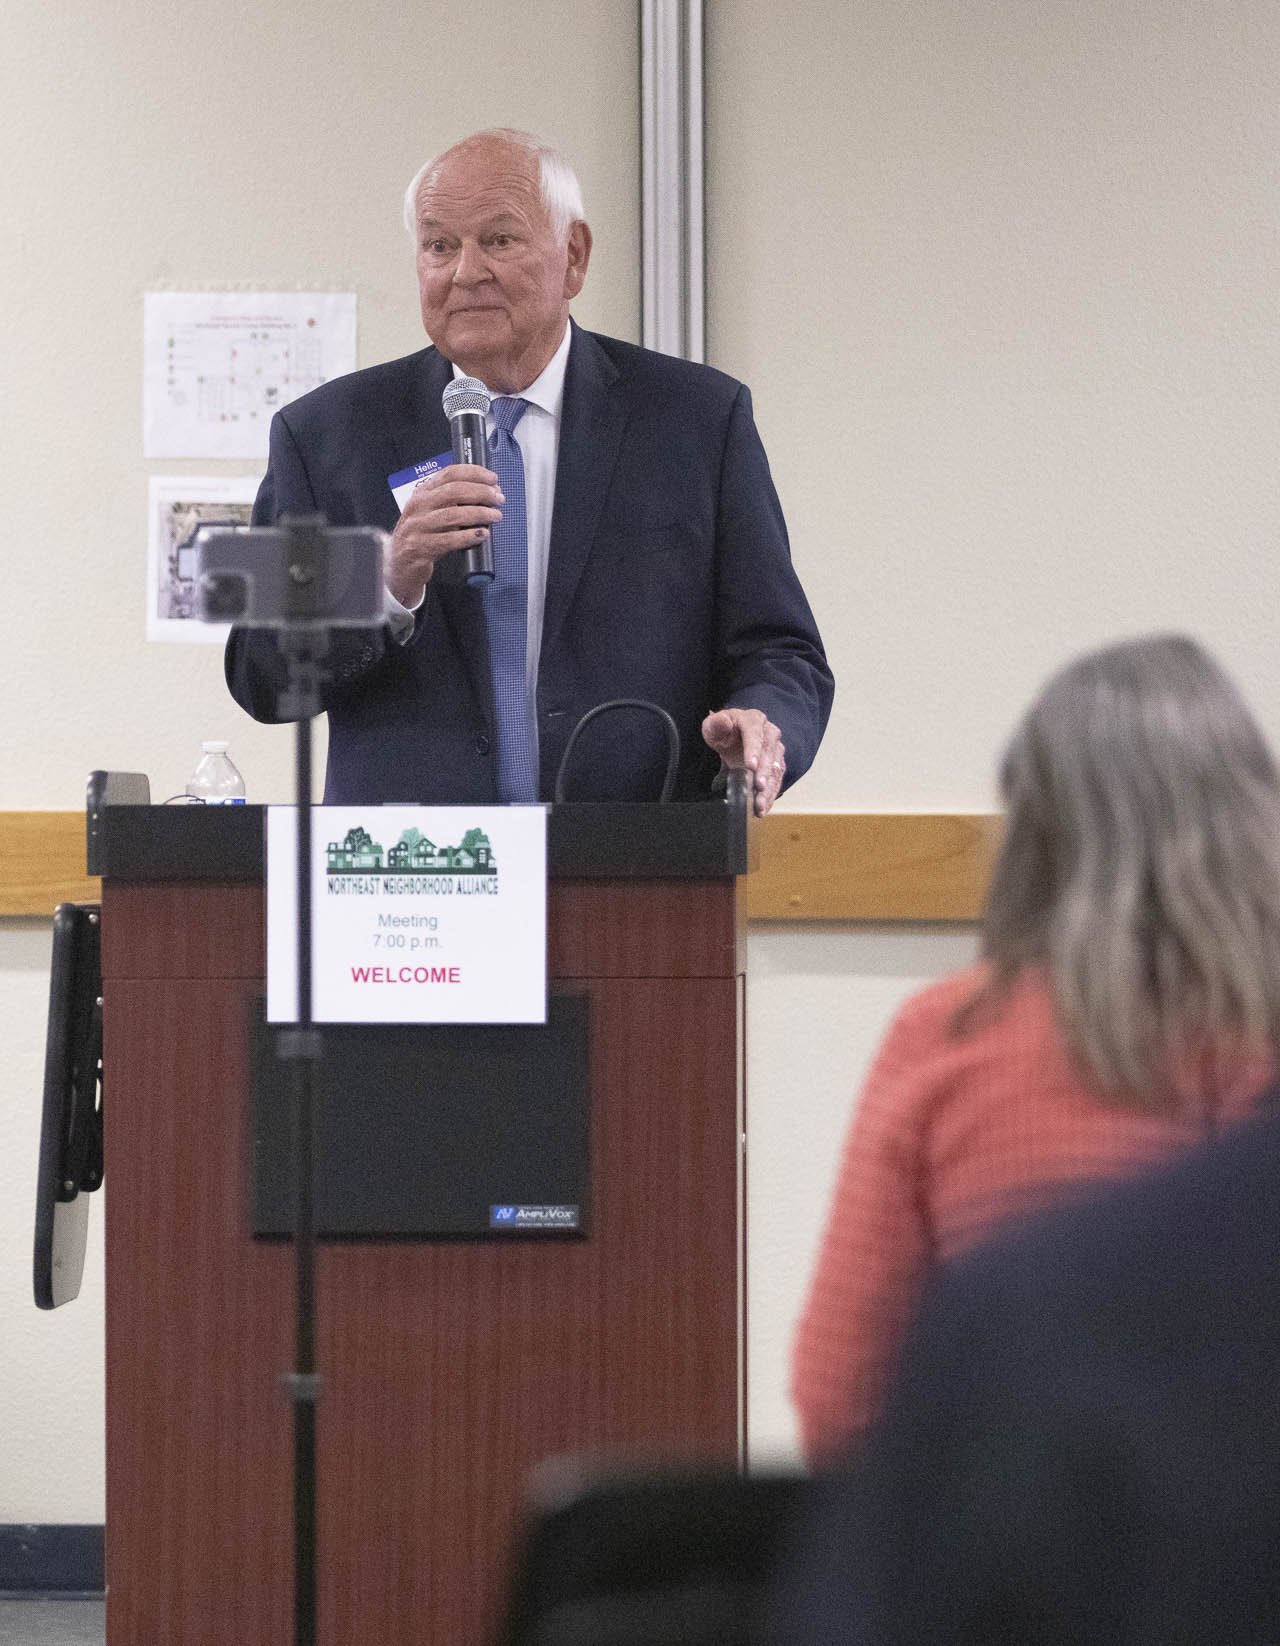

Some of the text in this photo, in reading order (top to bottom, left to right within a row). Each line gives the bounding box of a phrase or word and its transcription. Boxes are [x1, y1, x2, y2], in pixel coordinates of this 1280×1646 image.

[414, 461, 438, 475] Hello
[327, 877, 499, 895] NORTHEAST NEIGHBORHOOD ALLIANCE
[377, 913, 438, 931] Meeting
[373, 934, 444, 951] 7:00 p.m.
[351, 967, 461, 983] WELCOME
